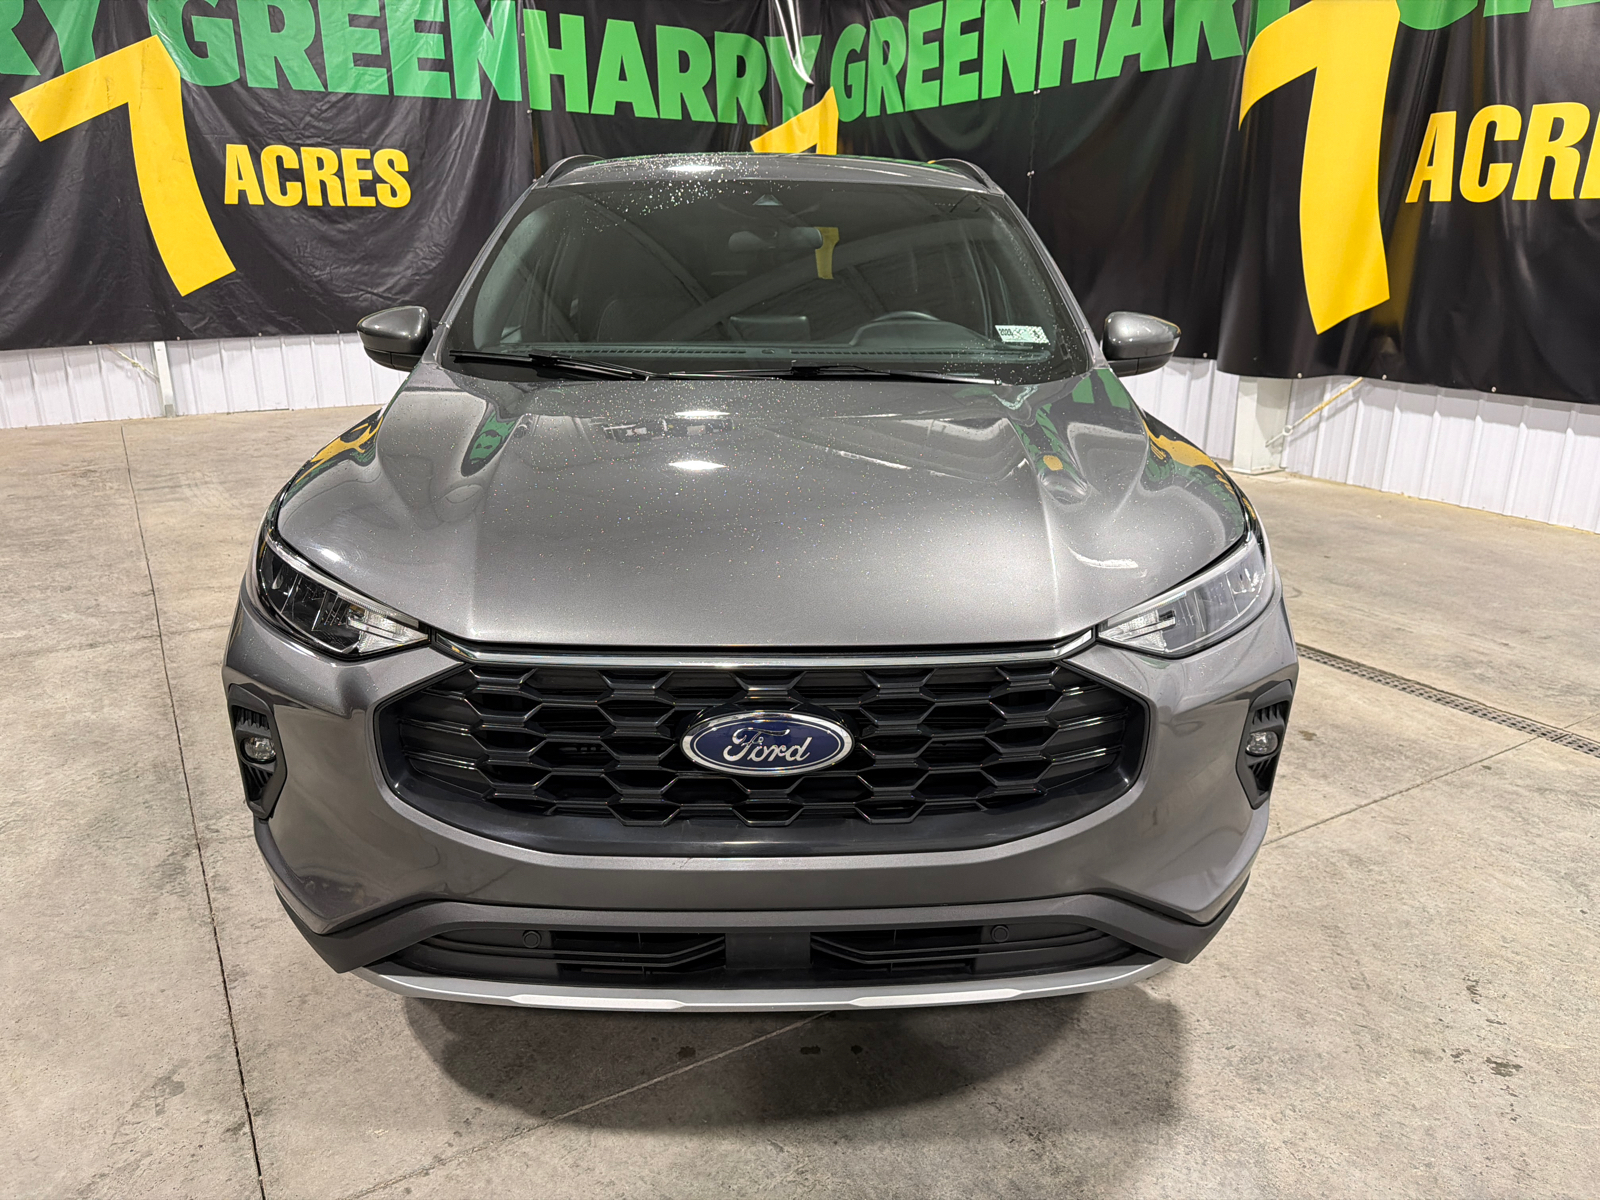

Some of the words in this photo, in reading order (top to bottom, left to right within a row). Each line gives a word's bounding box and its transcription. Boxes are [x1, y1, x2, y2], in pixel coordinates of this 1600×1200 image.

[148, 0, 523, 101] GREEN
[523, 8, 821, 126] HARRY
[830, 0, 1042, 122] GREEN
[1038, 0, 1290, 89] HA
[10, 34, 236, 297] 7
[224, 144, 412, 208] ACRES
[1239, 0, 1400, 335] 7
[722, 727, 813, 762] Ford
